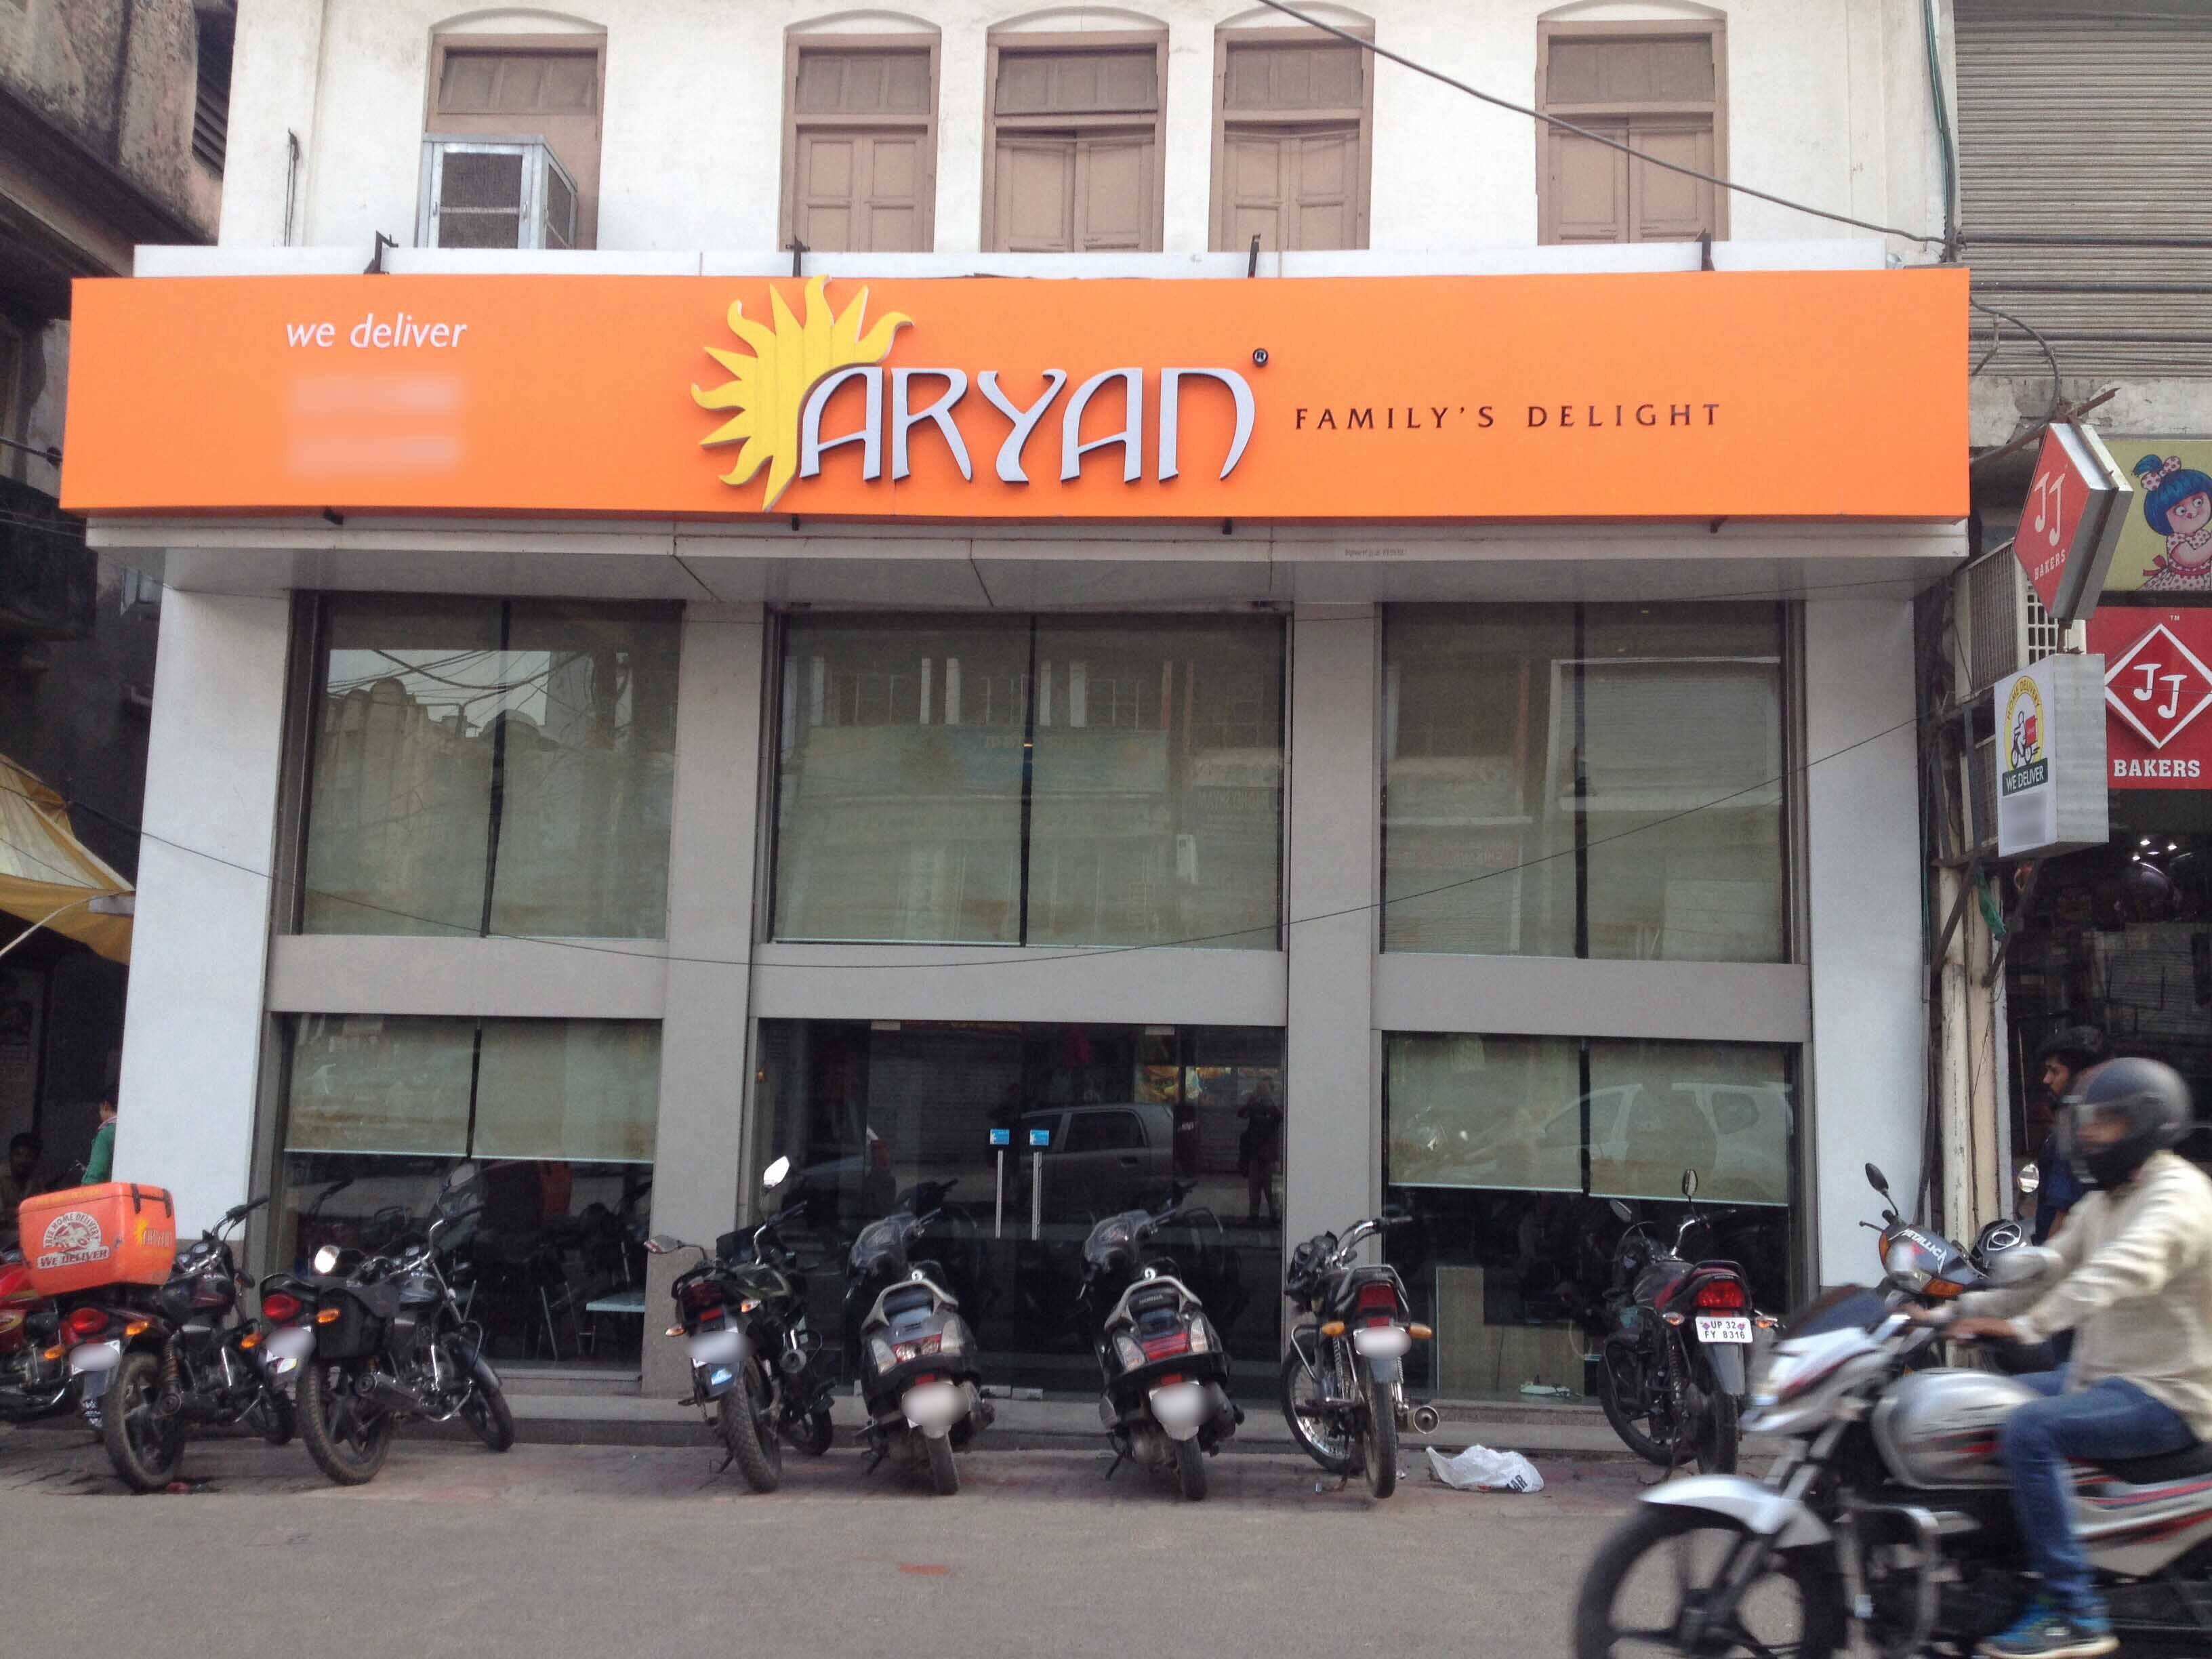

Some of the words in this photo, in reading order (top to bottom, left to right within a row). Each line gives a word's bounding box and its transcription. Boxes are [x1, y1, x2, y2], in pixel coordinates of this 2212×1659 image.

[286, 322, 335, 347] we
[350, 312, 467, 348] deliver
[799, 367, 1255, 483] ARYAN
[1295, 406, 1494, 430] FAMILY'S
[1528, 403, 1719, 428] DELIGHT
[2034, 472, 2065, 546] JJ
[2034, 548, 2066, 581] BAKERS
[2007, 687, 2019, 720] HOME
[2020, 680, 2040, 706] DELIVERY
[2133, 663, 2188, 718] JJ
[2006, 775, 2017, 792] WE
[2018, 765, 2044, 787] DELIVER
[2114, 759, 2200, 777] BAKERS
[52, 1214, 74, 1230] HOME
[41, 1256, 57, 1267] WE
[62, 1249, 108, 1263] DELIVER
[1887, 1227, 1948, 1275] METALLICA
[1704, 1331, 1716, 1339] FY
[1723, 1331, 1745, 1339] 8316
[1711, 1321, 1722, 1329] UP
[1725, 1321, 1736, 1329] 32
